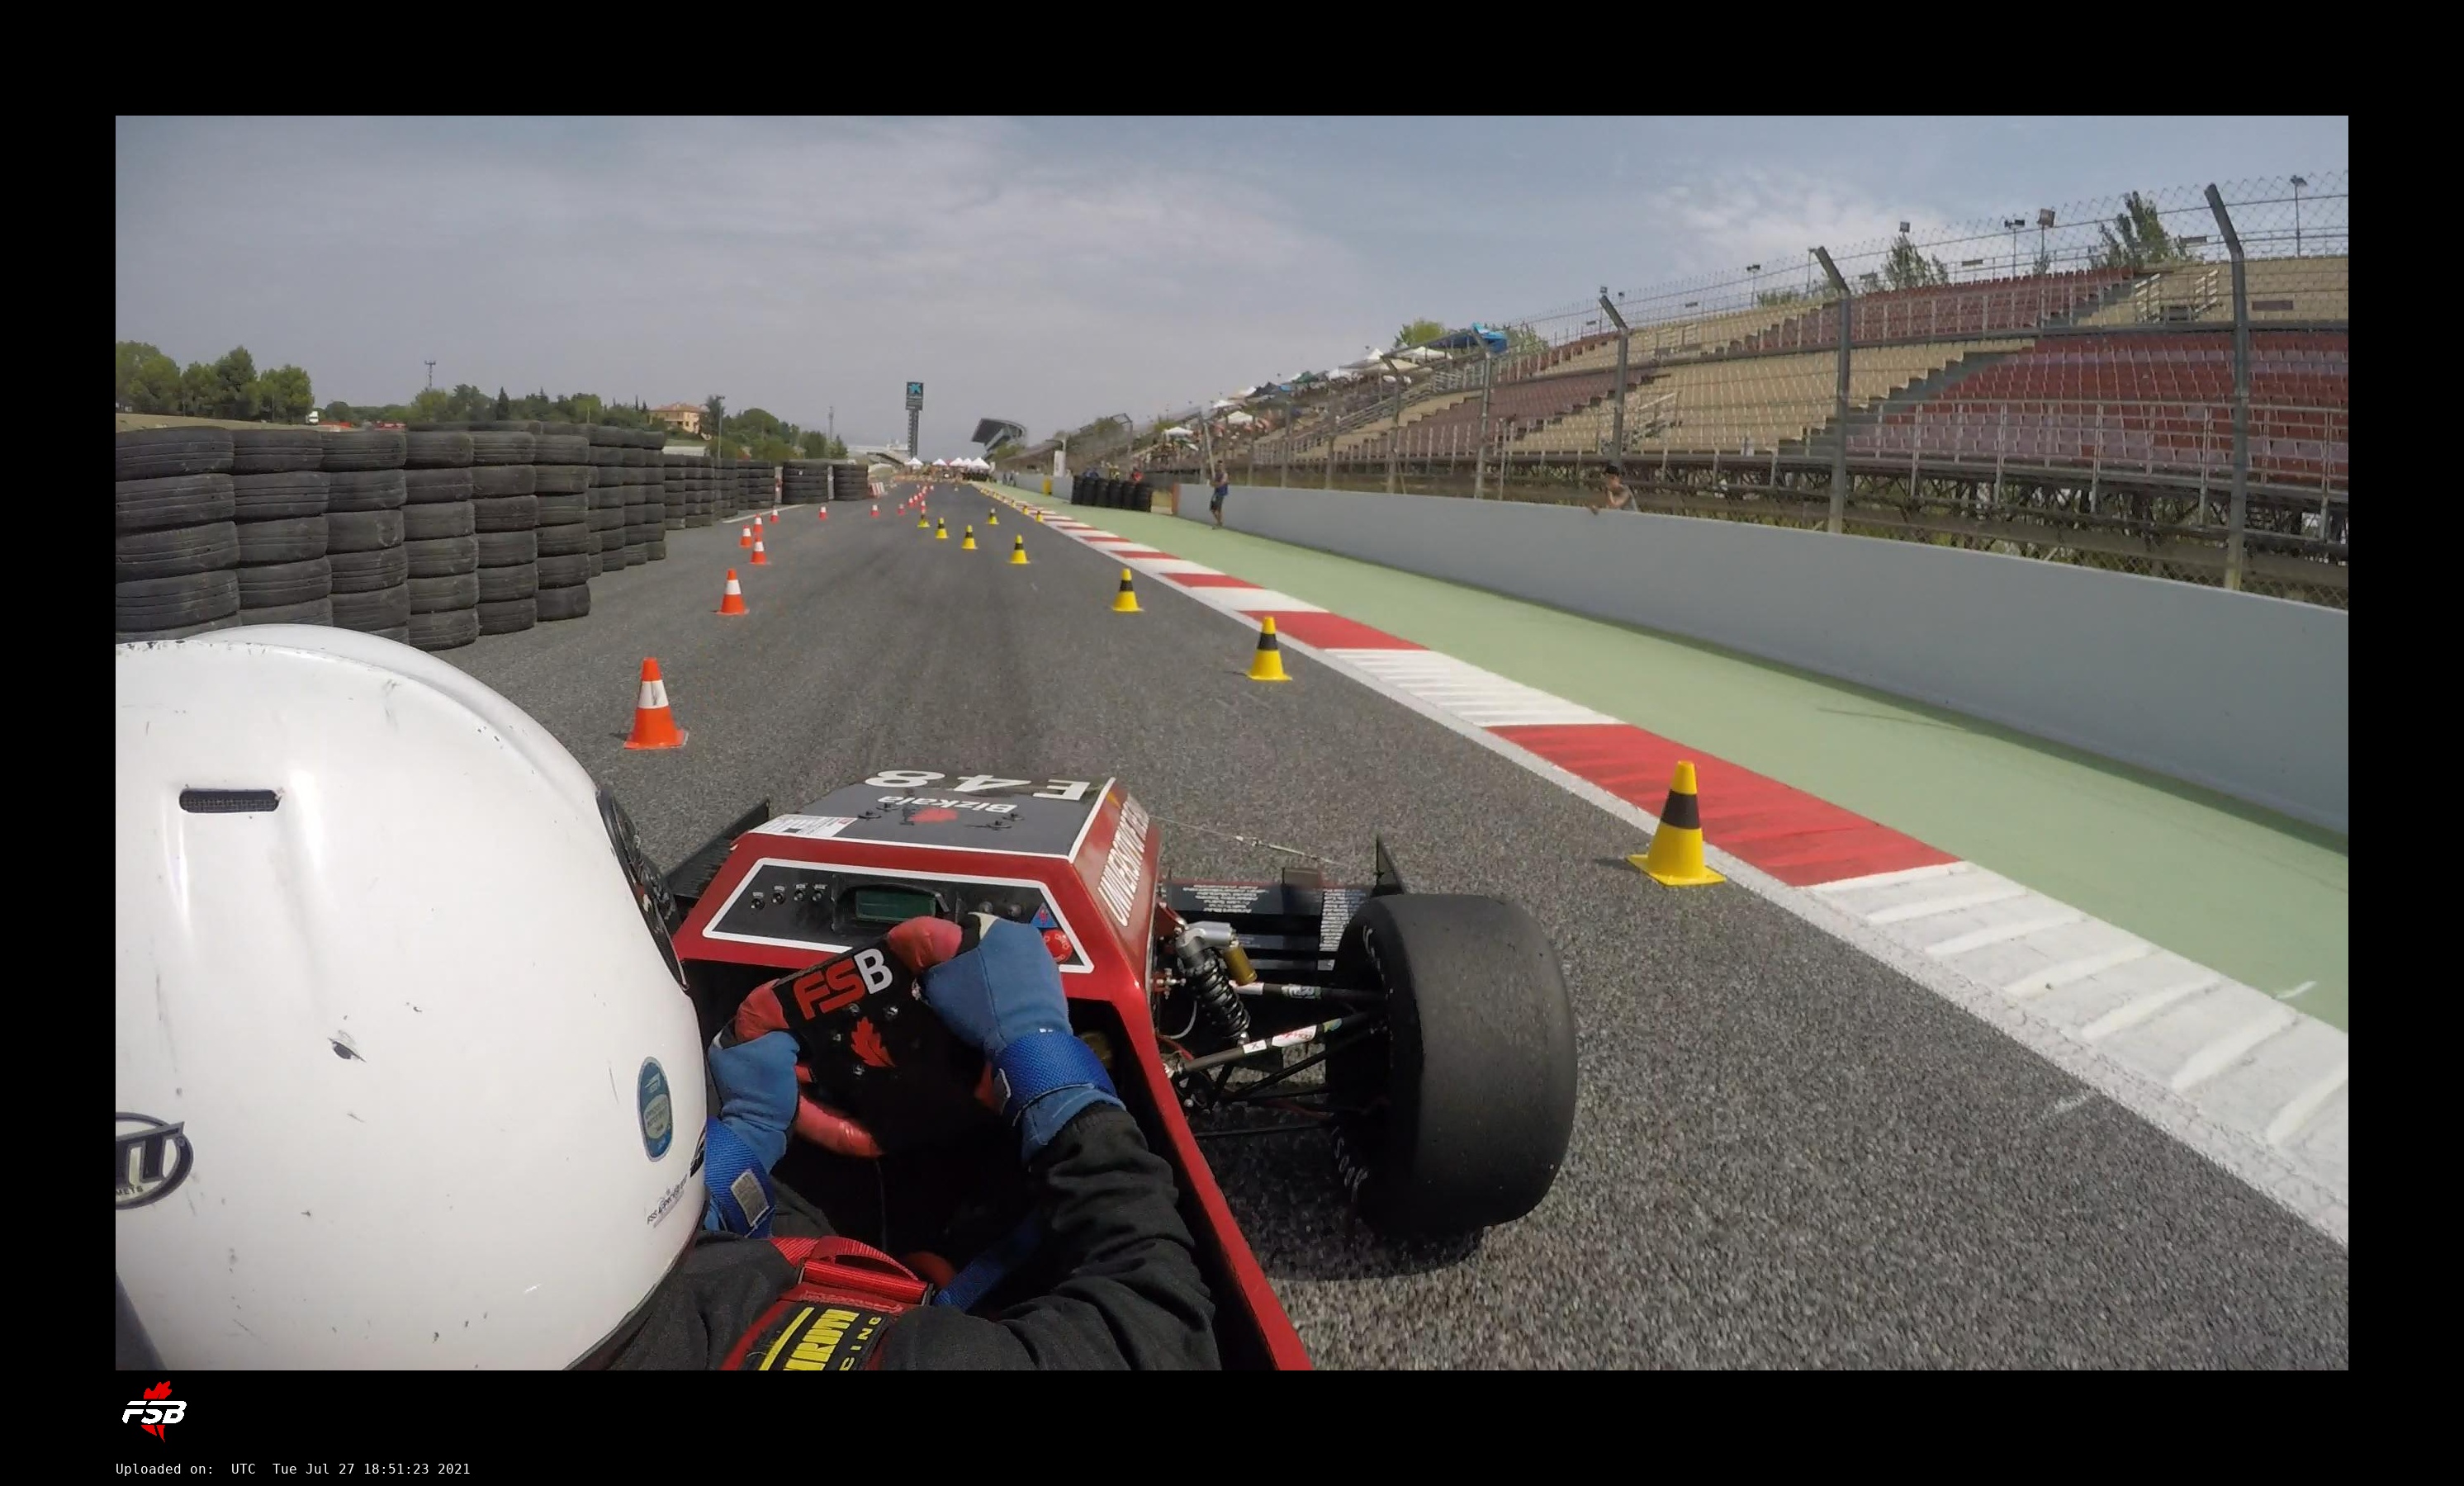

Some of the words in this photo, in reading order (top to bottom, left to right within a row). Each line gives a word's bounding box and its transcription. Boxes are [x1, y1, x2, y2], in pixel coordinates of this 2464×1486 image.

[865, 770, 1090, 801] E48
[1097, 826, 1142, 927] UNIVERSITY
[793, 949, 893, 1020] FSB
